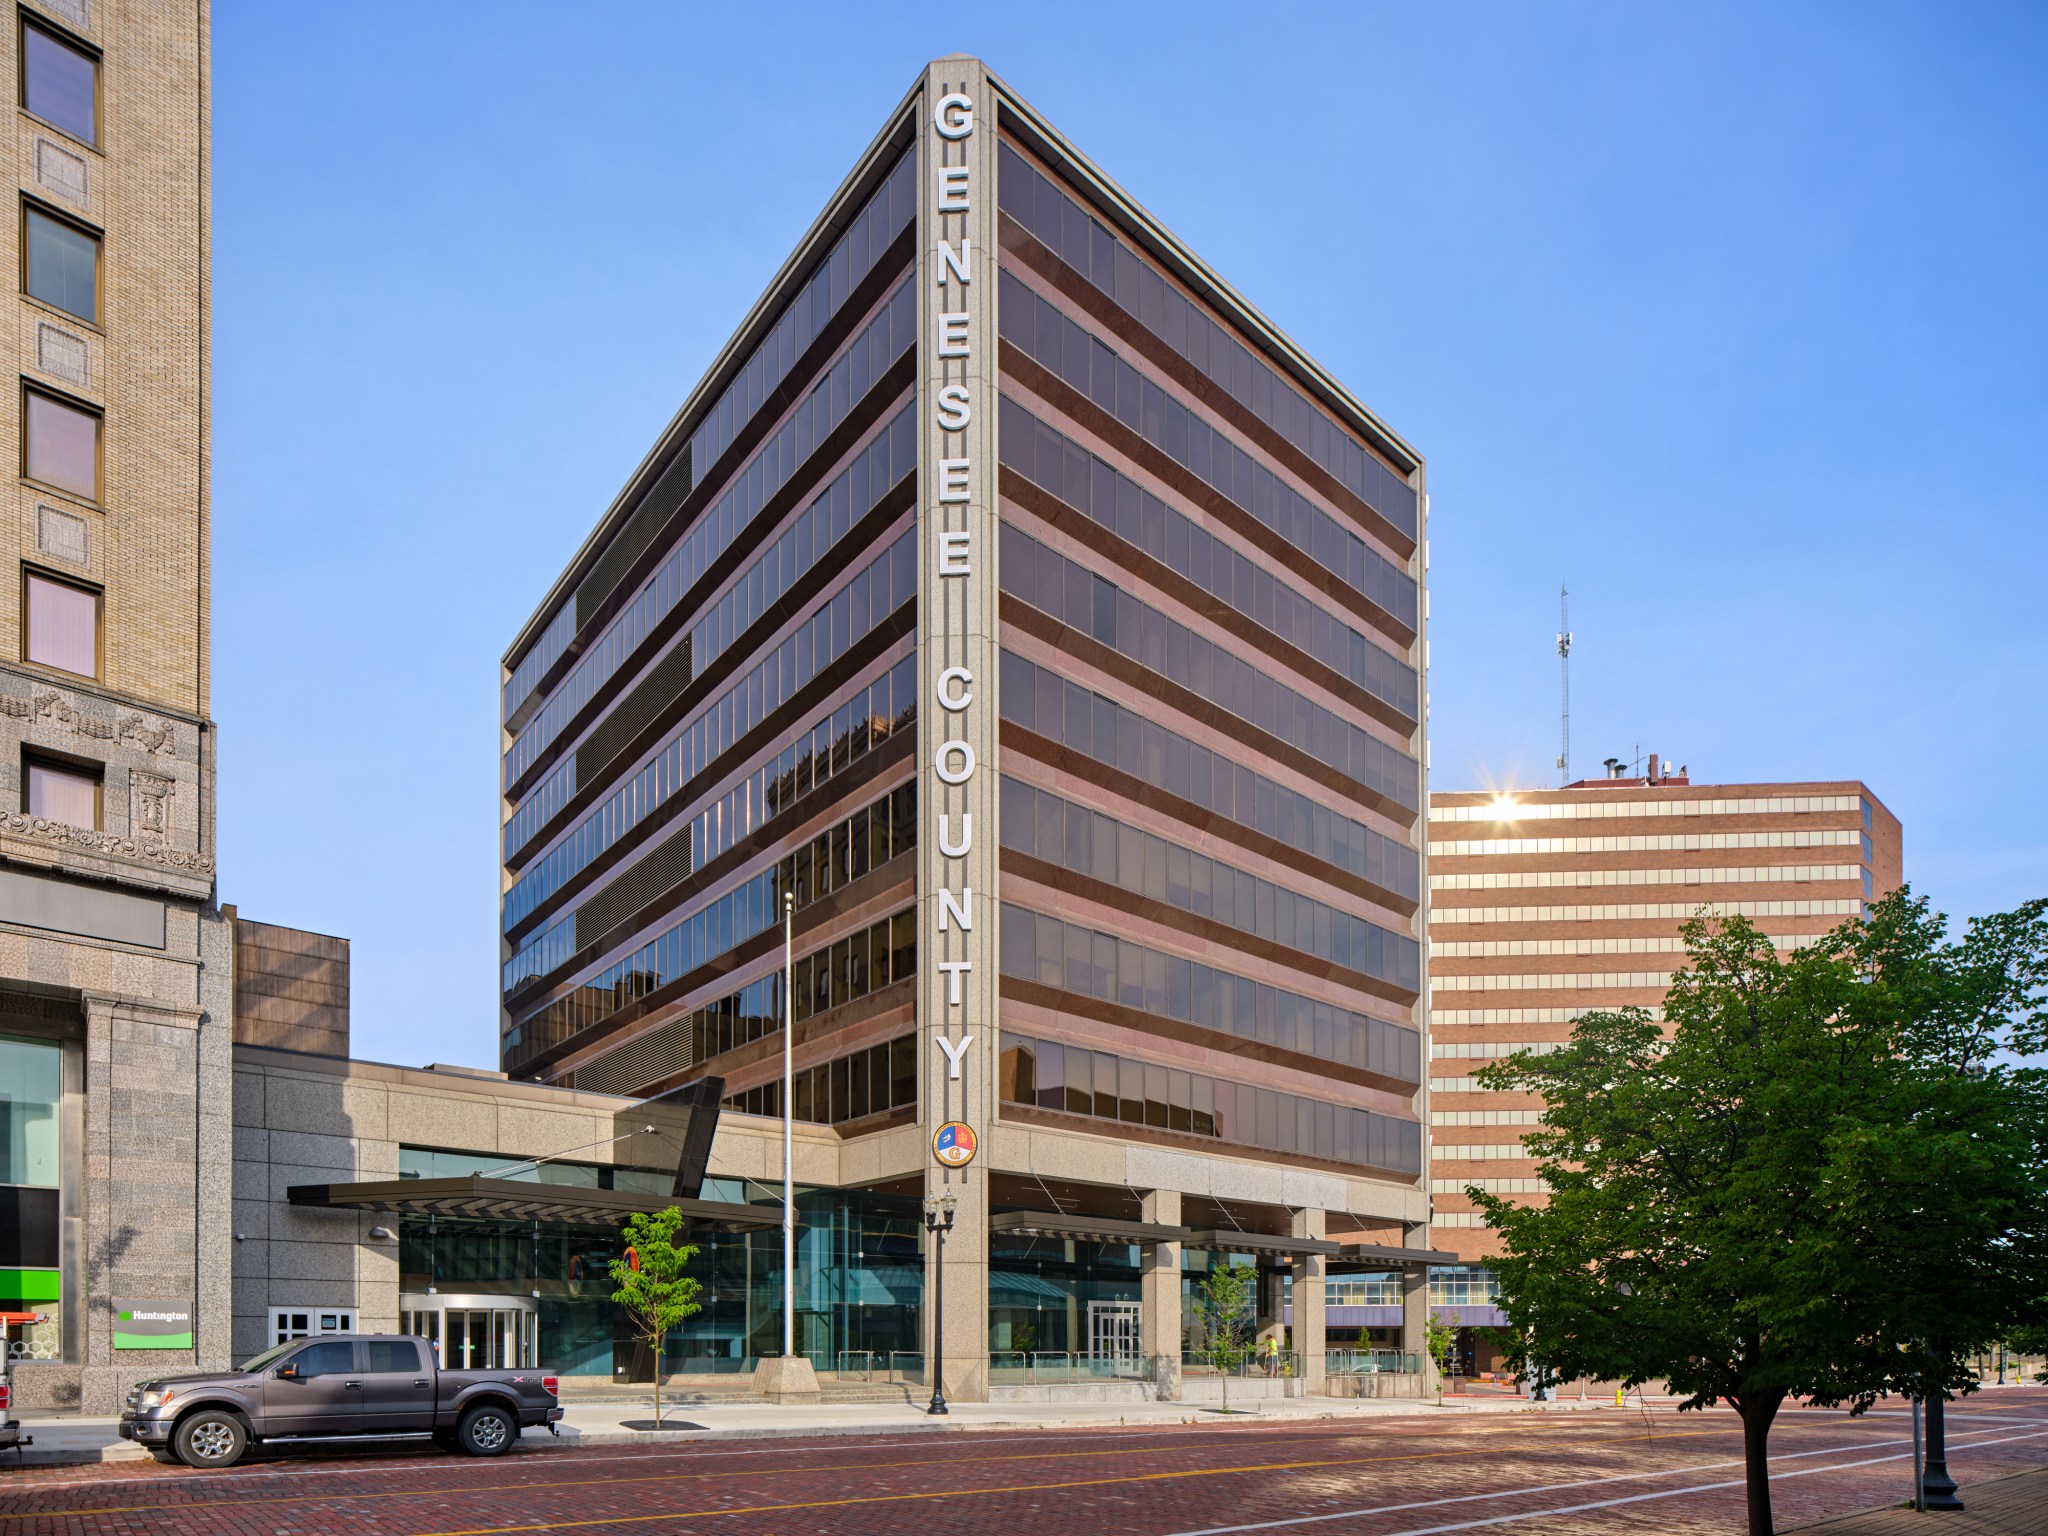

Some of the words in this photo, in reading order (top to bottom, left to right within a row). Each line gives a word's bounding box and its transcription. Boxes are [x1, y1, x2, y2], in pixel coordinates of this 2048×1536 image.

[934, 92, 973, 576] GENESEE
[935, 666, 975, 1079] COUNTY
[133, 1310, 188, 1323] Huntington
